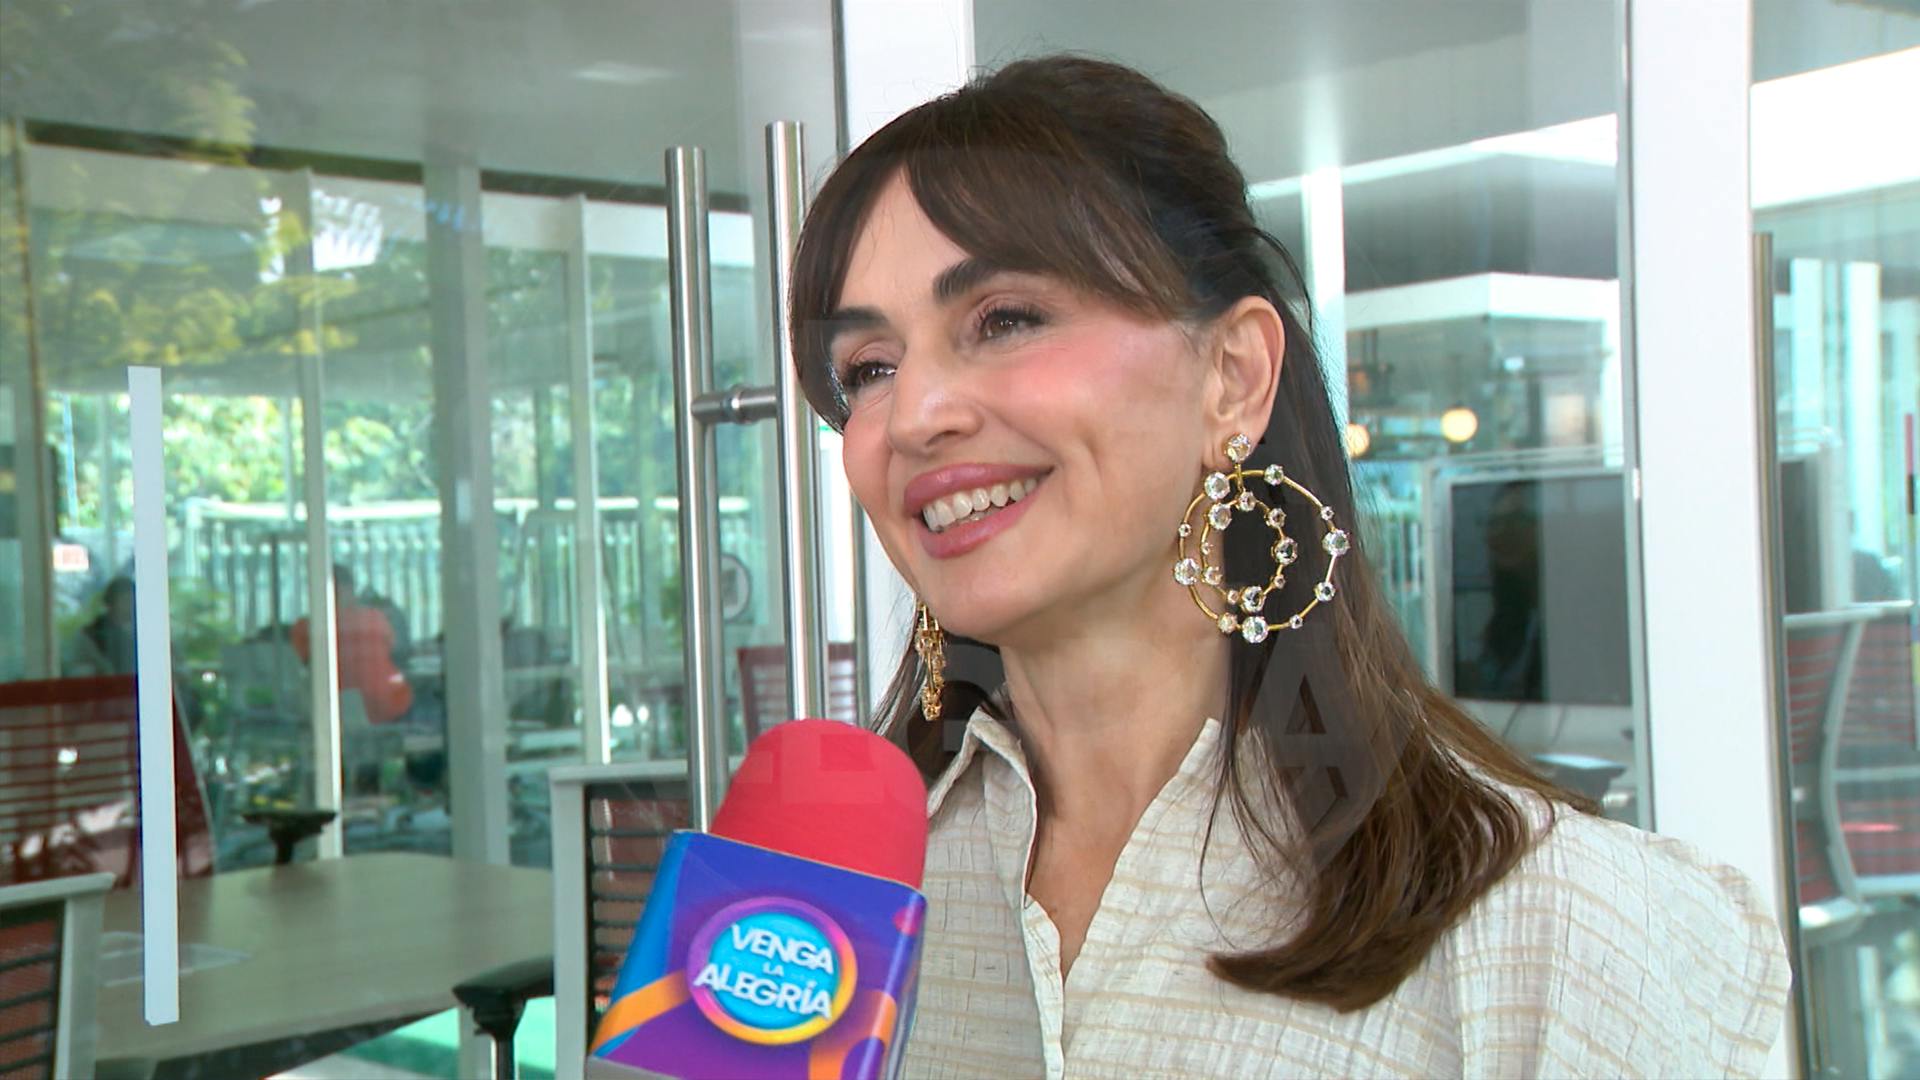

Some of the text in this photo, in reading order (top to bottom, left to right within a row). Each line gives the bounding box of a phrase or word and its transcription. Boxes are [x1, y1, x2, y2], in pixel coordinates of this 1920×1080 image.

[732, 923, 834, 975] VENGA
[762, 961, 785, 977] LA
[693, 962, 832, 1020] ALEGRÍA
